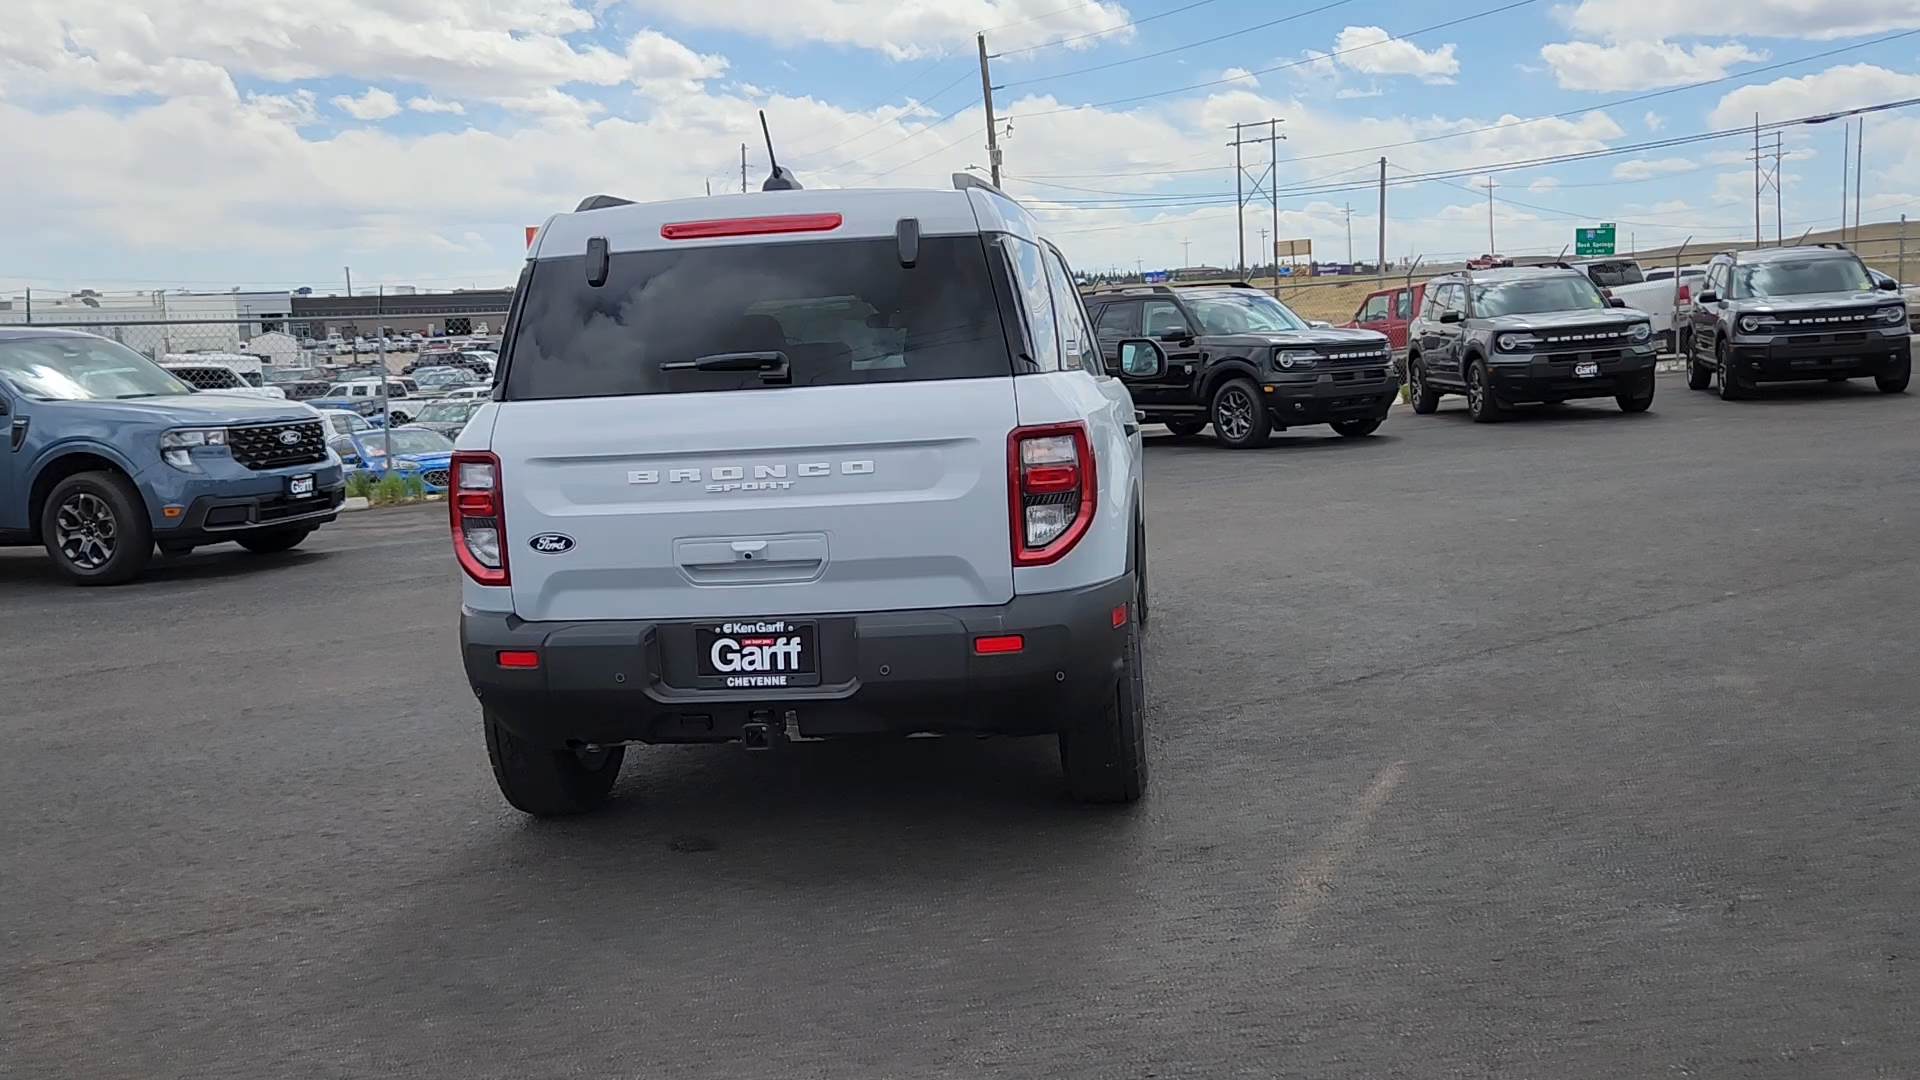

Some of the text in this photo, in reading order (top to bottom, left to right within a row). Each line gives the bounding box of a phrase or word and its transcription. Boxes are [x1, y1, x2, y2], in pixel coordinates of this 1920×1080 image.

[1592, 241, 1614, 249] Springs
[1788, 314, 1866, 325] BRONCO
[1547, 332, 1619, 342] BRONCO
[1329, 350, 1382, 360] BRONCO
[627, 460, 875, 484] BRONCO
[291, 477, 314, 495] Garff
[705, 480, 795, 493] SPORT
[536, 537, 567, 550] Ford
[733, 621, 785, 634] Ken Garff
[711, 636, 802, 672] Garff
[726, 676, 787, 687] CHEYENNE
